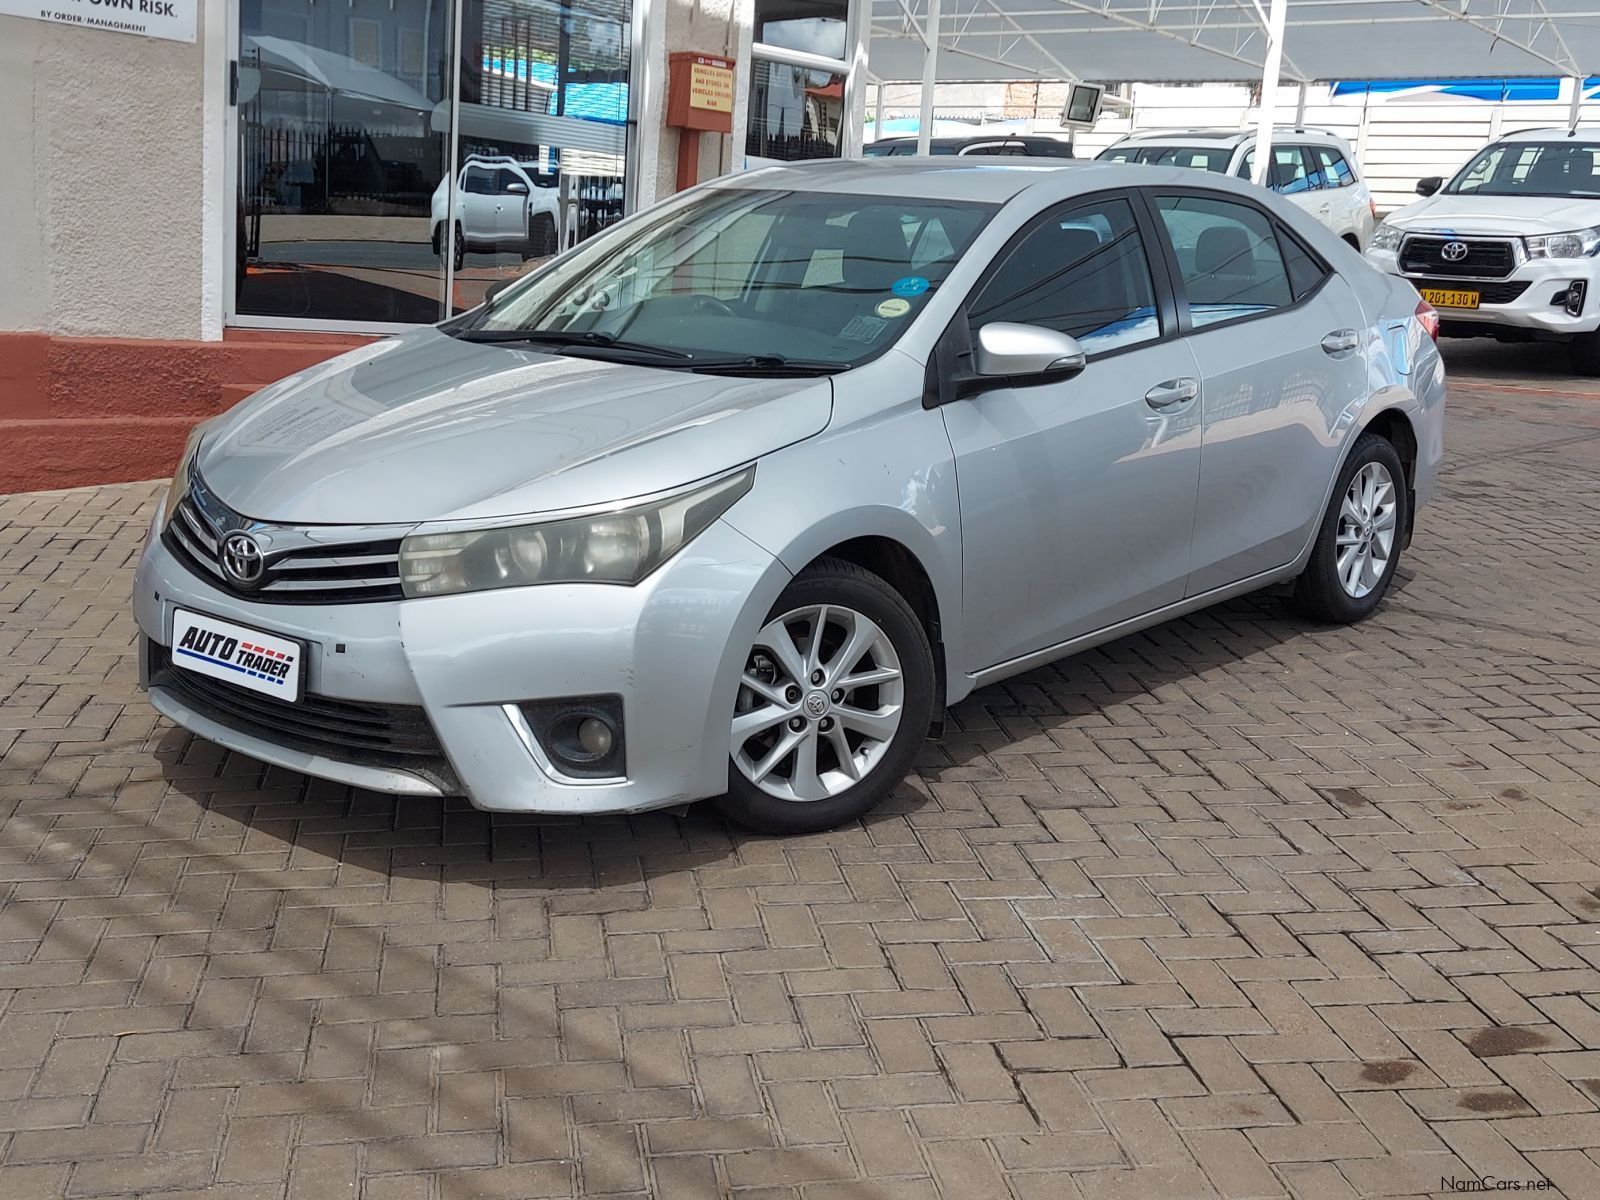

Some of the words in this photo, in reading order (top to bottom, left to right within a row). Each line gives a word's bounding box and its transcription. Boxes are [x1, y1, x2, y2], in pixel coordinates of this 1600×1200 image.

[40, 9, 51, 18] BY
[54, 12, 82, 22] ORDER
[86, 17, 146, 32] MANAGEMENT
[1429, 292, 1468, 305] 201-130
[1470, 294, 1478, 306] W
[179, 626, 239, 661] AUTO
[236, 650, 291, 679] TRADER
